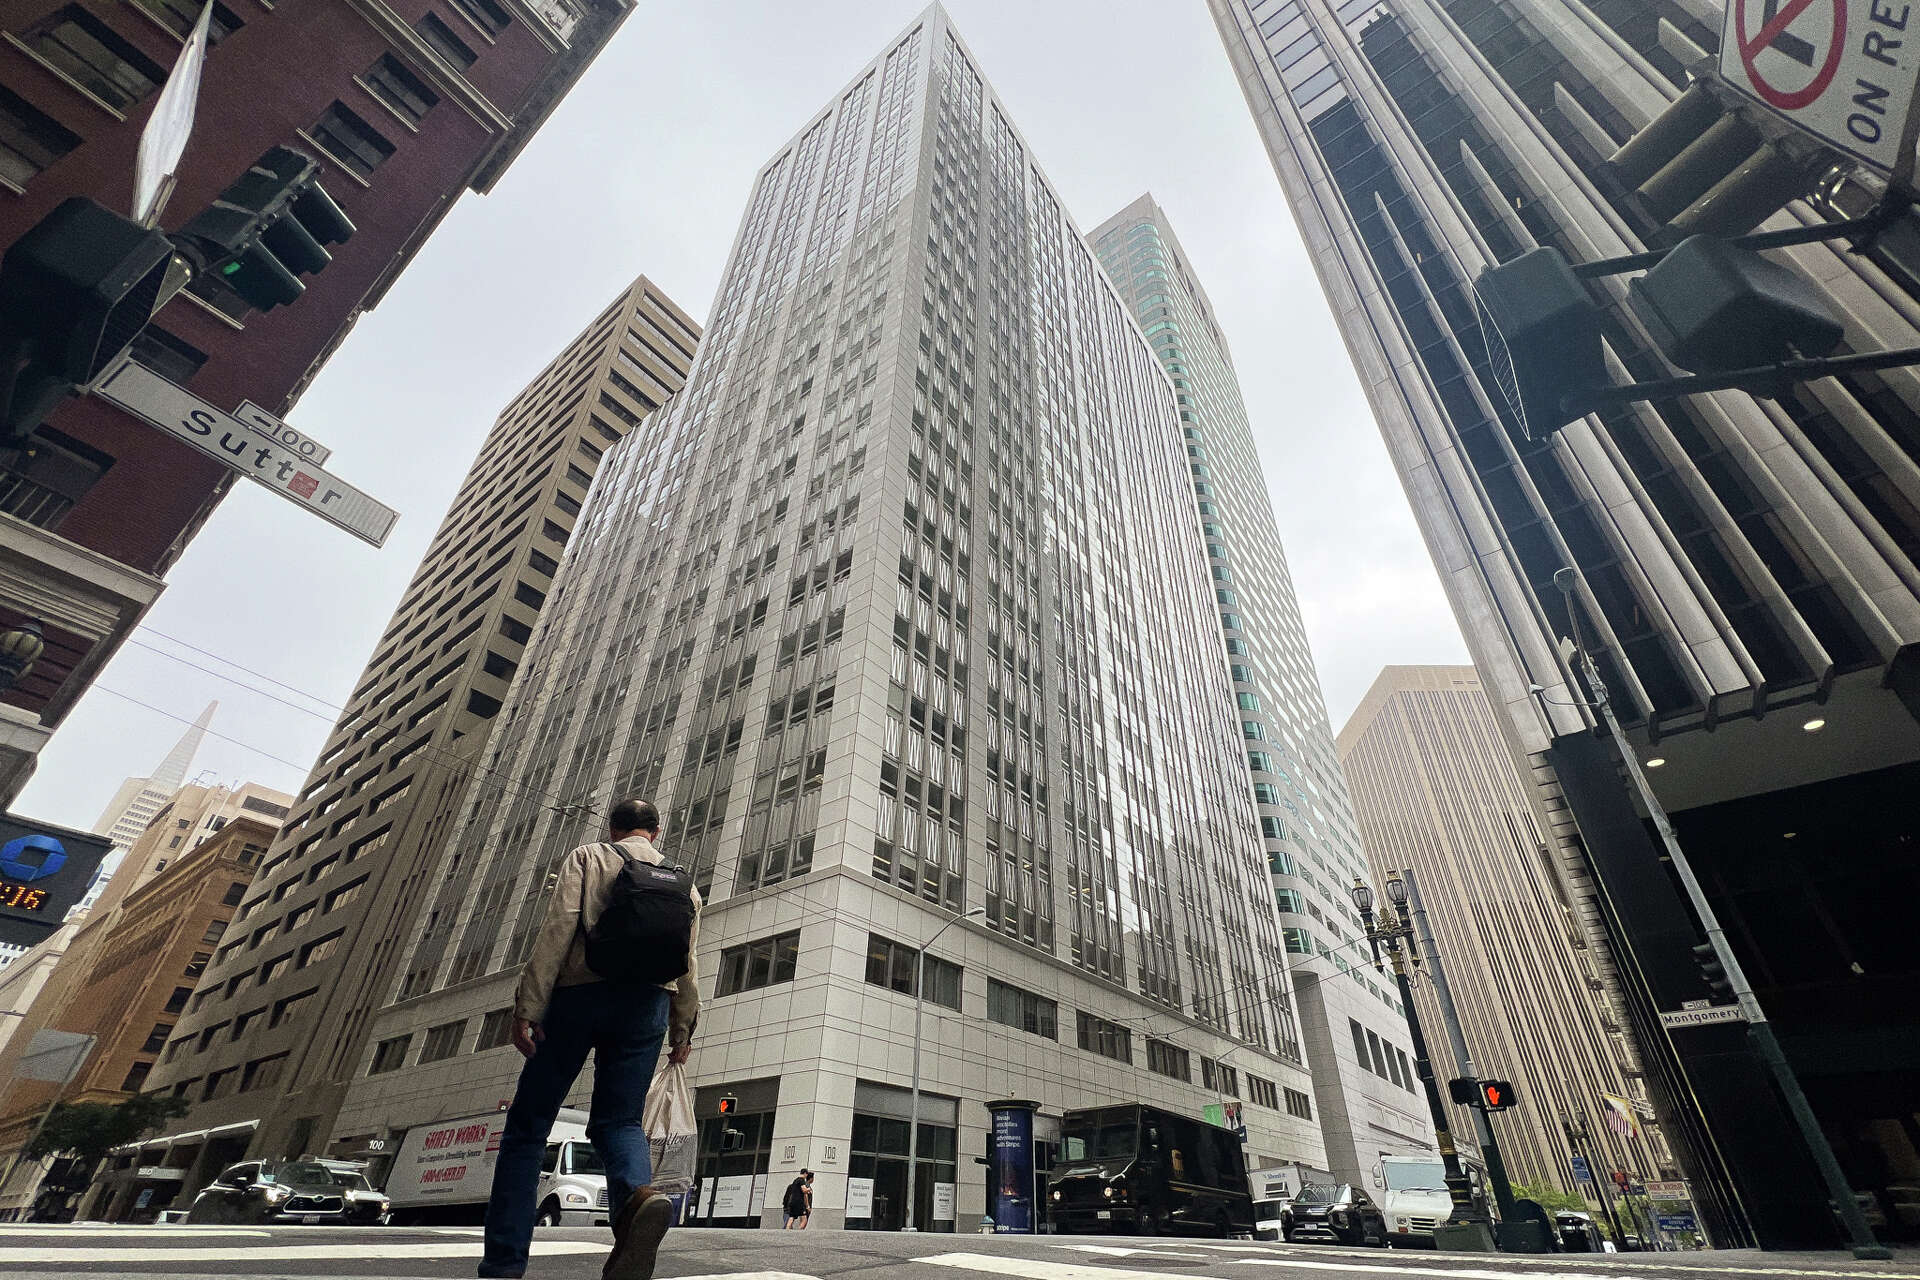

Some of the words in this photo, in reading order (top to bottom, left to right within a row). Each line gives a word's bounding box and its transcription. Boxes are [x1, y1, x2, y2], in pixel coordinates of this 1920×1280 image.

[1847, 78, 1889, 143] ON
[271, 424, 317, 456] 100
[181, 409, 343, 504] Suttr
[0, 882, 46, 910] :16
[1664, 1009, 1739, 1024] Montgomery
[369, 1140, 385, 1151] 100
[422, 1128, 456, 1151] SHRED
[454, 1123, 489, 1146] WORKS
